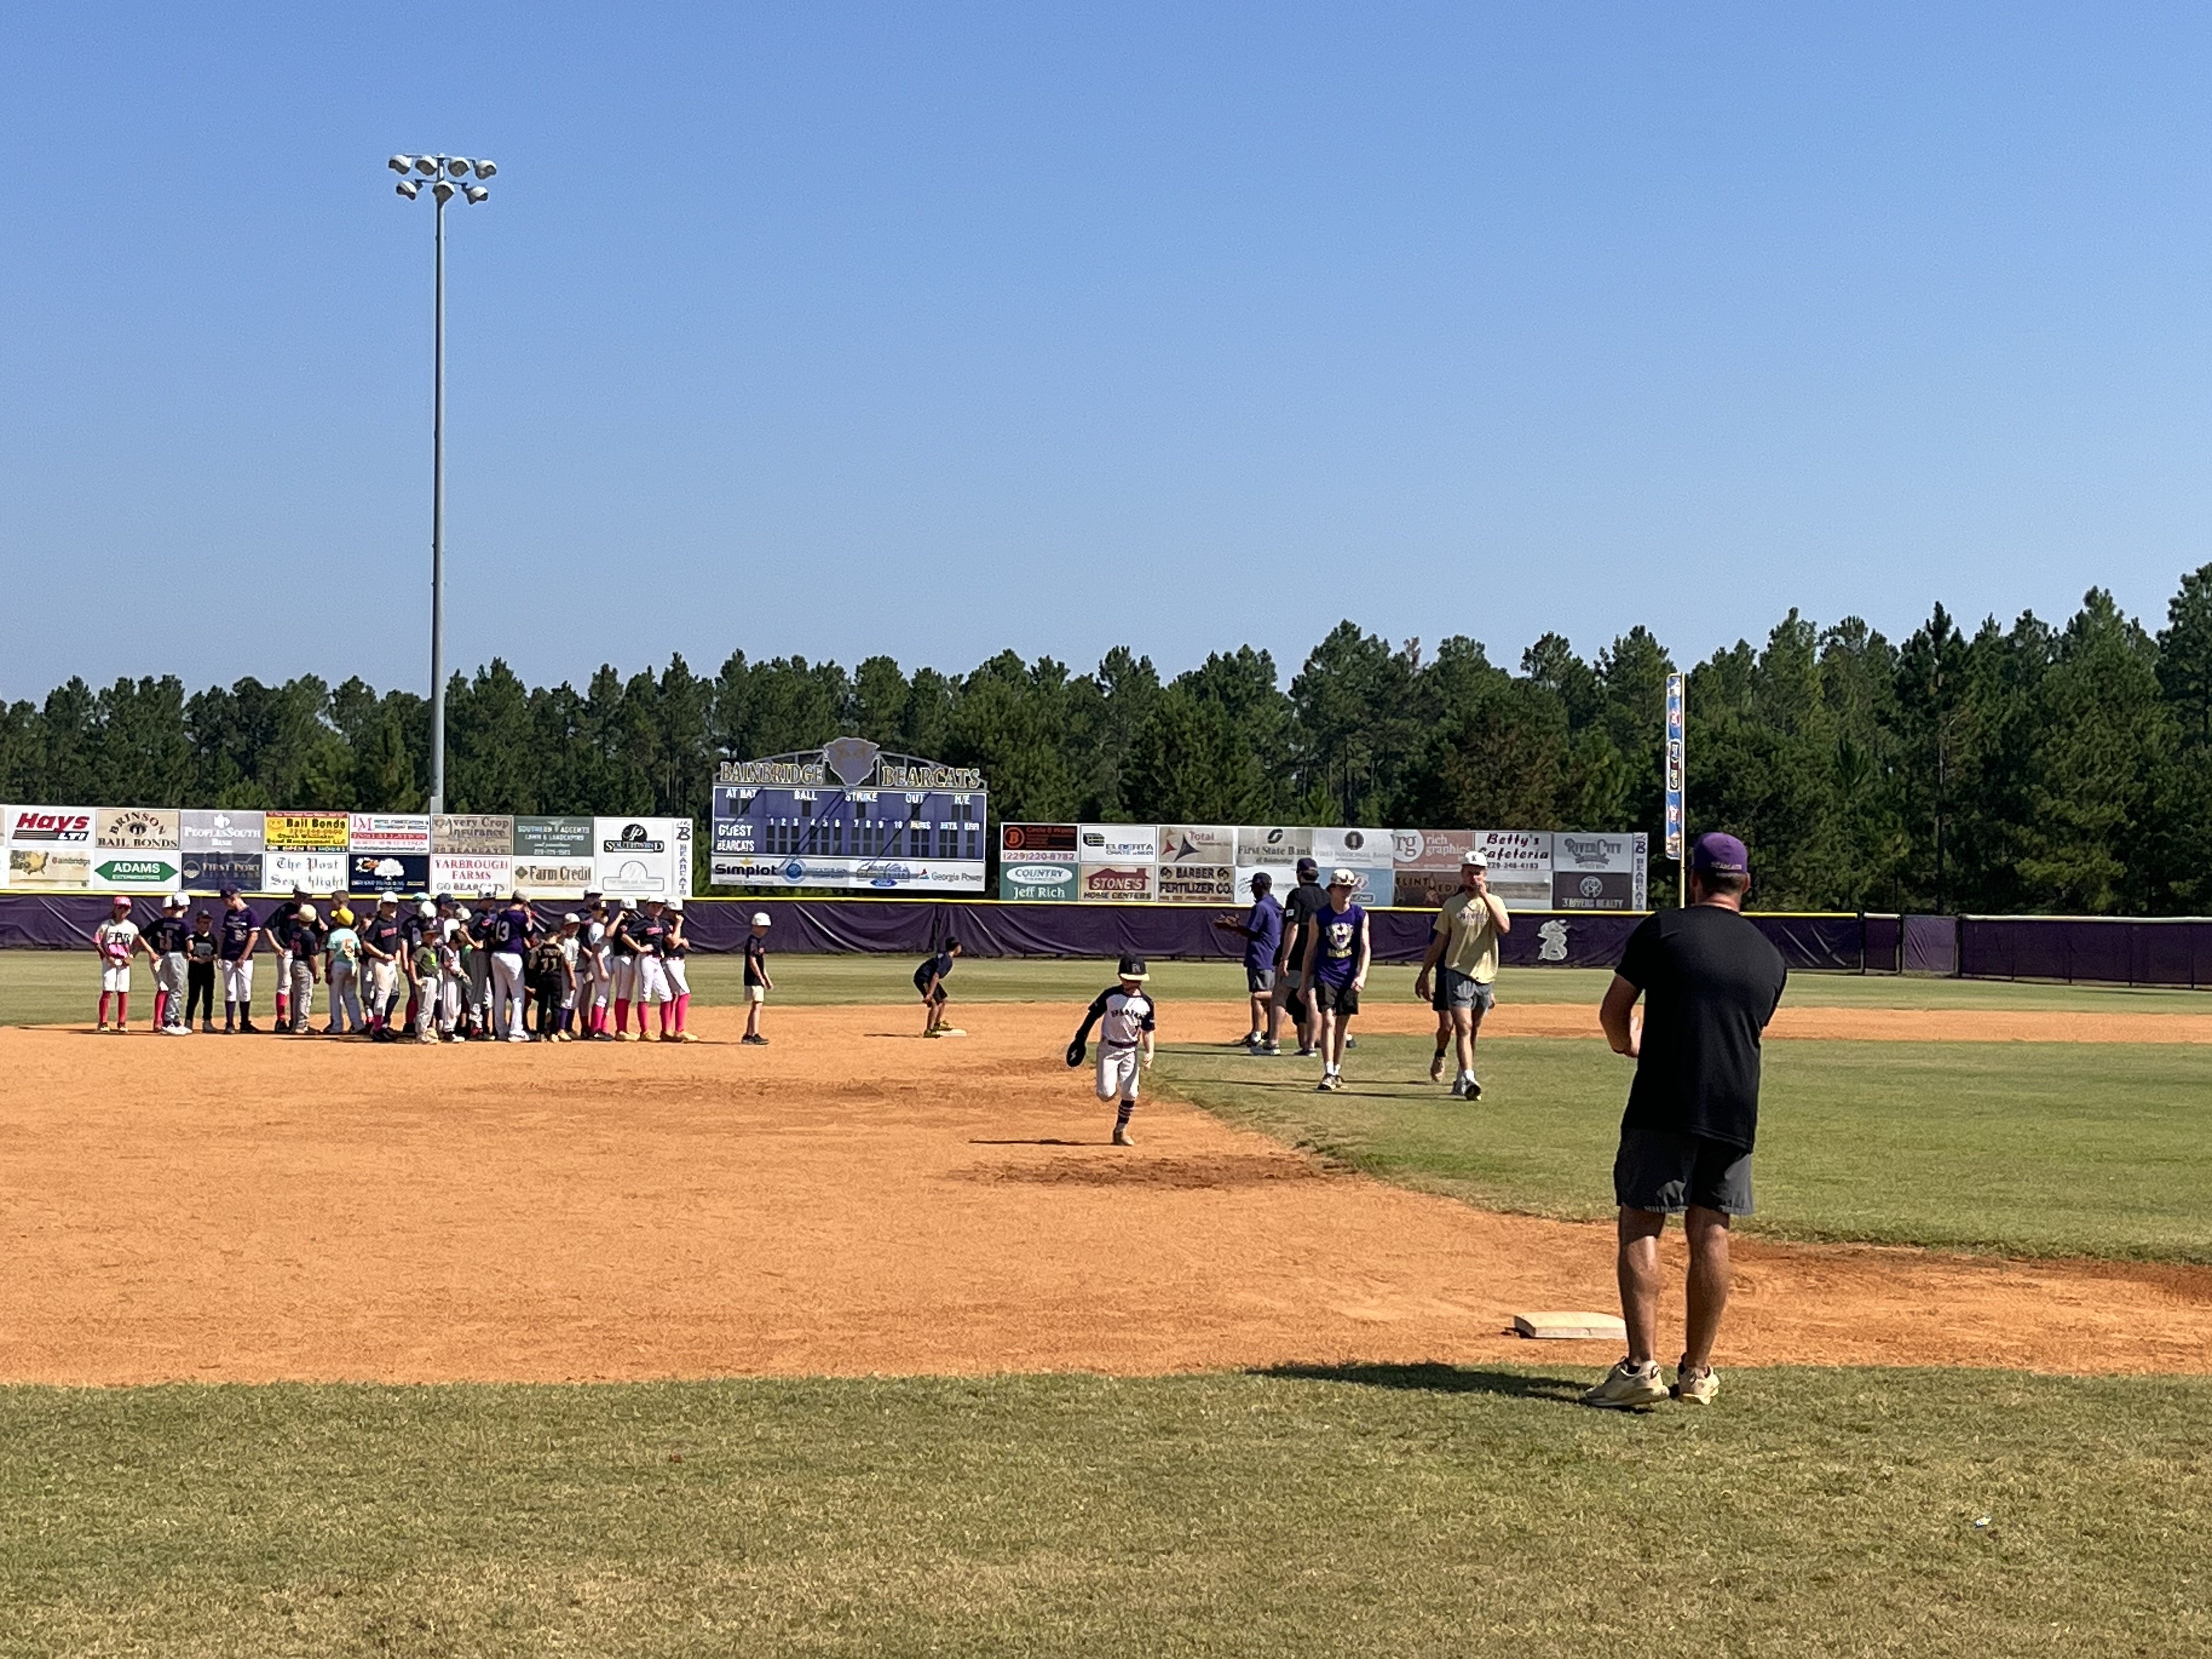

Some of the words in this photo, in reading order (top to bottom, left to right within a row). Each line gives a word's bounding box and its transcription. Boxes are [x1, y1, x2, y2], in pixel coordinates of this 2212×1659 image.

[720, 761, 823, 785] BAINBRIDGE
[882, 766, 980, 788] BEARCATS
[726, 789, 737, 798] AT
[740, 789, 757, 798] BAT
[794, 790, 817, 800] BALL
[845, 792, 878, 802] STRIKE
[906, 793, 923, 803] OUT
[16, 812, 90, 833] Hays
[109, 812, 166, 834] BRINSON
[286, 818, 308, 827] Bail
[312, 818, 345, 828] Bonds
[482, 817, 509, 828] Crop
[781, 817, 787, 826] 2
[793, 817, 798, 826] 3
[823, 819, 828, 827] 5
[834, 819, 840, 827] 6
[854, 819, 859, 827] 7
[866, 820, 871, 828] 8
[449, 828, 505, 838] Insurance
[719, 824, 753, 836] GUEST
[1189, 830, 1214, 840] Total
[98, 838, 130, 847] BAIL
[133, 839, 177, 847] BONDS
[1426, 834, 1447, 844] rich
[1487, 834, 1539, 848] Betty's
[716, 840, 754, 851] BEARCATS
[1238, 845, 1259, 854] First
[1262, 846, 1285, 855] State
[1288, 847, 1312, 855] Bank
[1395, 836, 1417, 857] rg
[112, 863, 160, 873] ADAMS
[276, 857, 302, 872] The
[307, 857, 338, 872] Post
[435, 860, 508, 869] YARBROUGH
[452, 871, 491, 879] FARMS
[529, 865, 557, 881] Farm
[560, 865, 591, 881] Credit
[715, 864, 778, 878] Simplot
[1176, 867, 1214, 878] BARBER
[932, 873, 959, 882] Georgia
[1092, 878, 1143, 889] STONE'S
[1159, 882, 1214, 893] FERTILIZER
[1014, 887, 1036, 900] Jeff
[1038, 887, 1065, 898] Rich
[496, 920, 510, 941] 13
